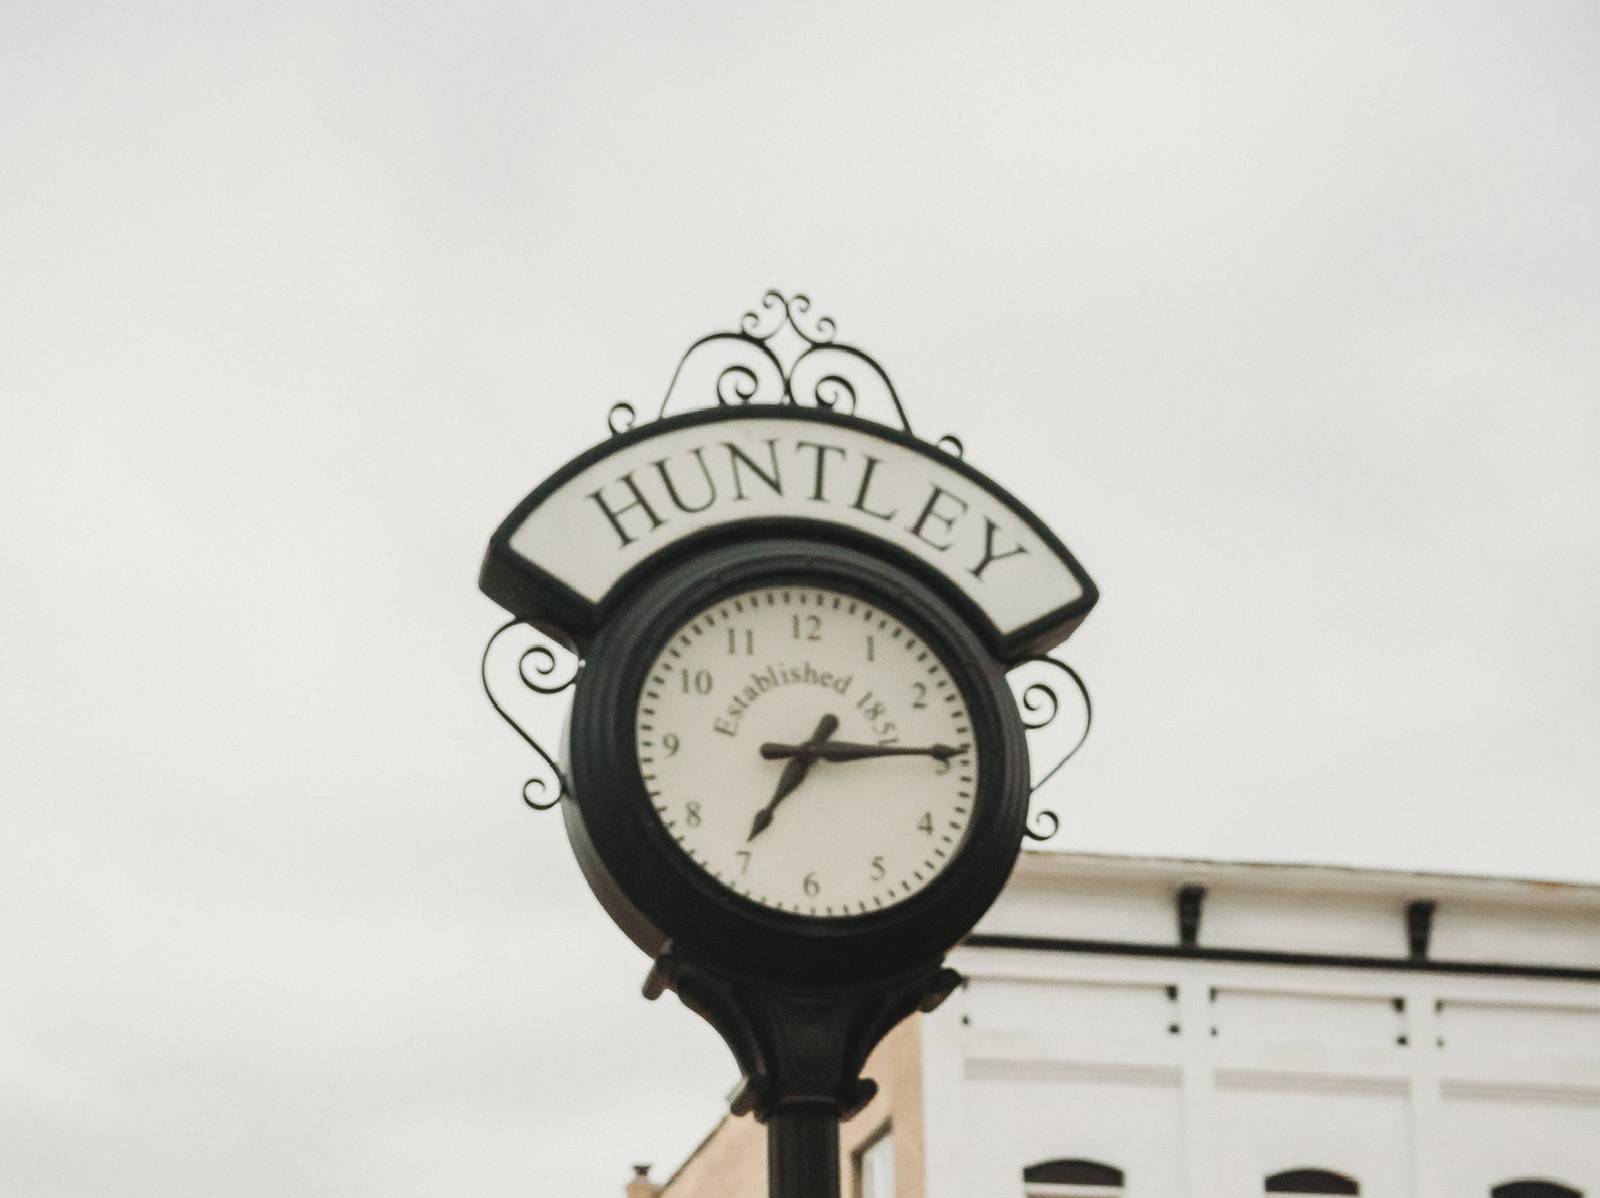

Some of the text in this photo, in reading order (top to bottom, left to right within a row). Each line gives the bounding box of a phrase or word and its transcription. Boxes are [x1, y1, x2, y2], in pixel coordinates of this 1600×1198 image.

[586, 438, 1028, 580] HUNTLEY
[791, 615, 822, 641] 12
[727, 628, 754, 655] 11
[865, 635, 876, 662] 1
[680, 669, 713, 695] 10
[713, 662, 853, 738] Established
[912, 682, 928, 709] 2
[662, 733, 680, 758] 9
[685, 801, 702, 826] 8
[917, 812, 933, 836] 4
[736, 850, 751, 875] 7
[871, 856, 886, 881] 5
[804, 872, 820, 897] 6
